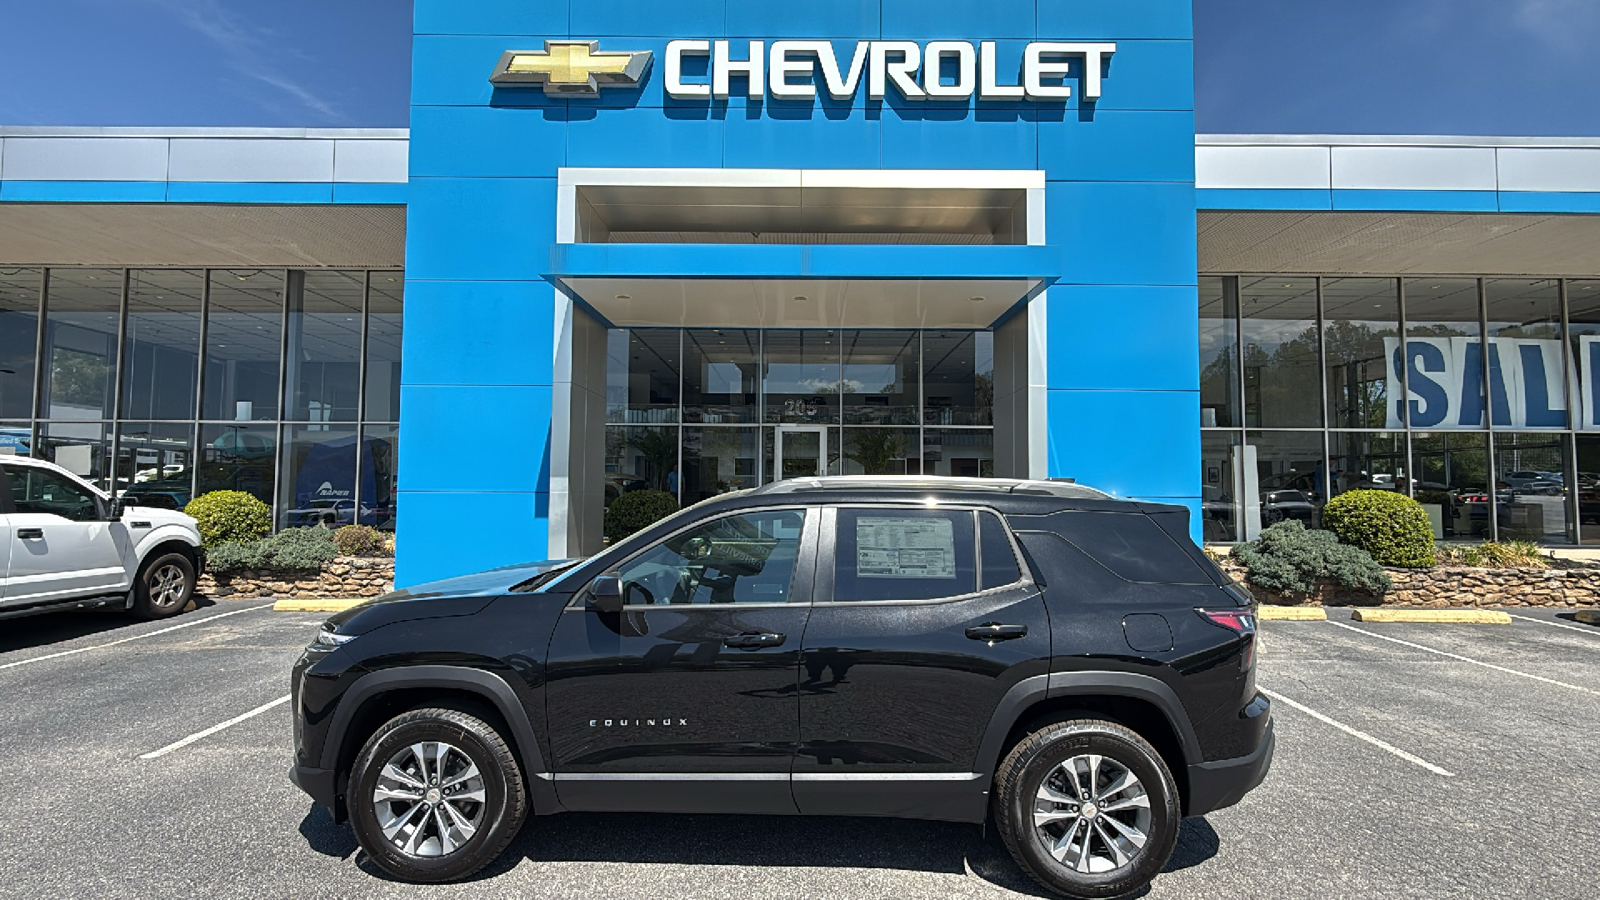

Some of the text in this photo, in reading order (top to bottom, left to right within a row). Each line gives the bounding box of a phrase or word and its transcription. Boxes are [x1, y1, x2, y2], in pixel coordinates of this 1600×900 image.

[664, 40, 1116, 100] CHEVROLET
[1393, 341, 1600, 428] SAL
[784, 399, 818, 416] 205
[589, 718, 688, 728] EQUINOX
